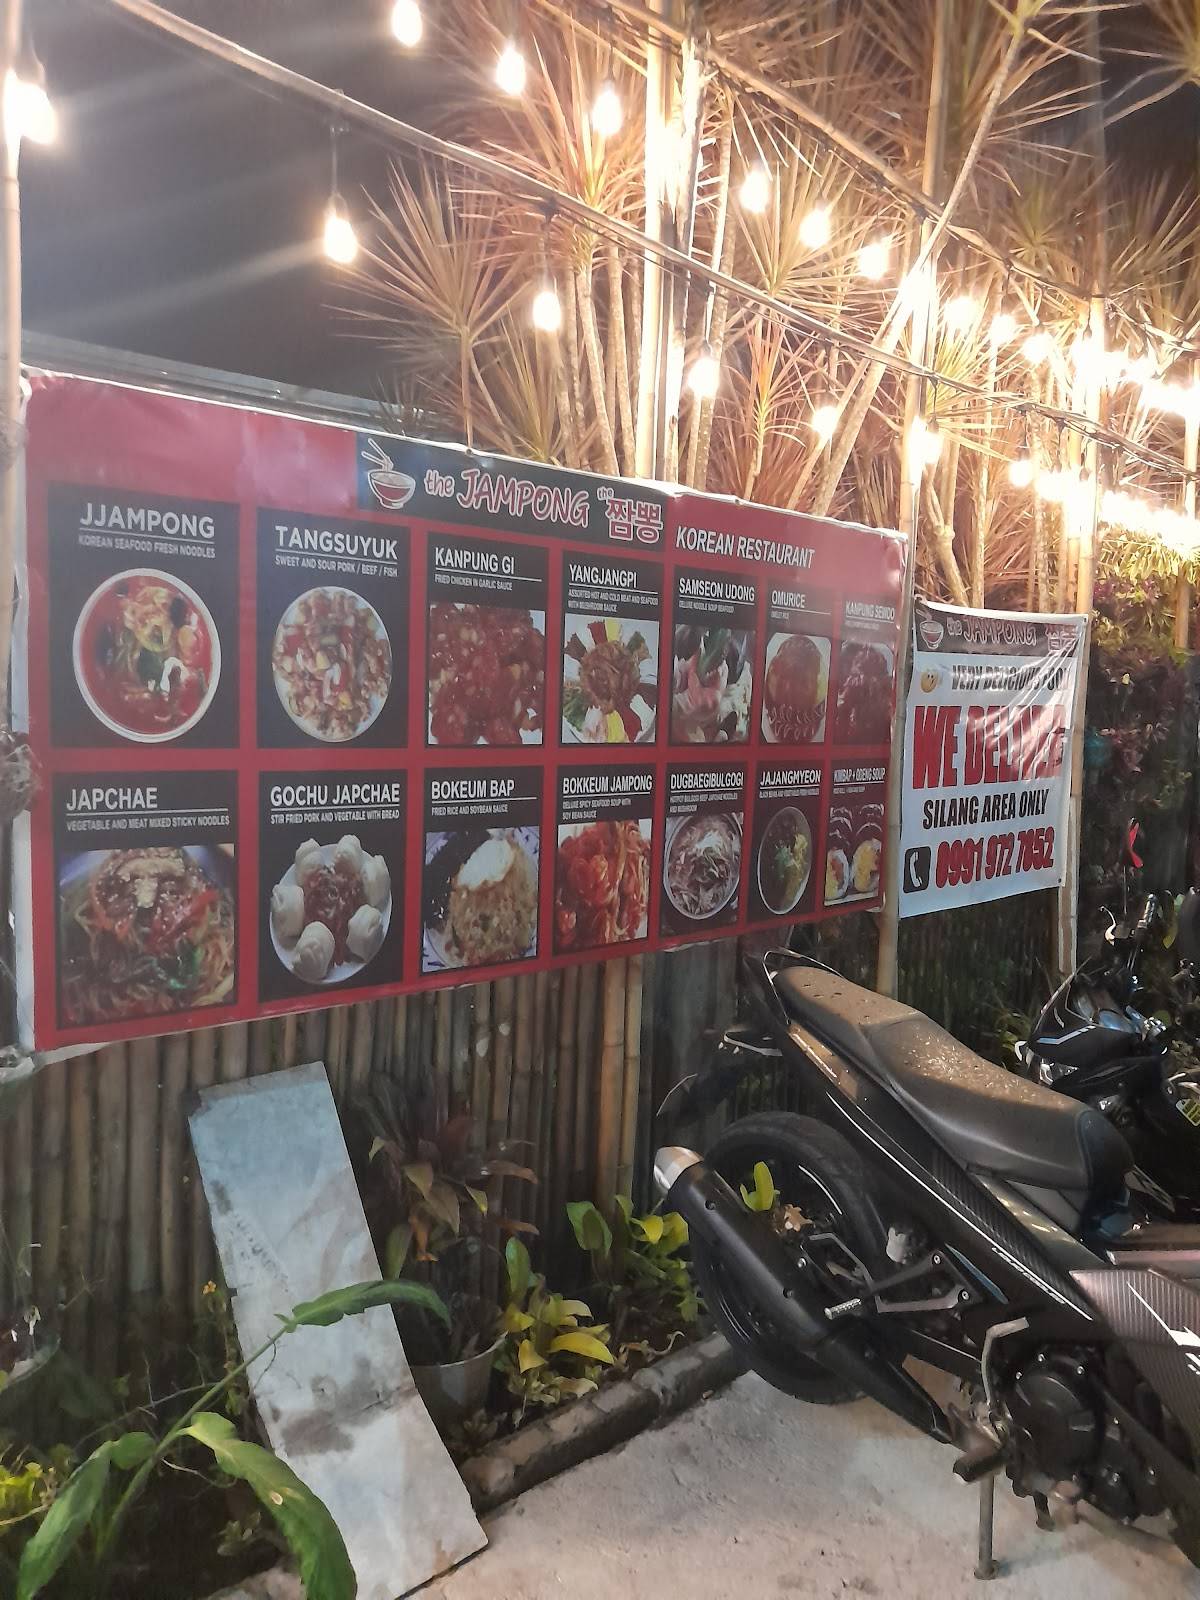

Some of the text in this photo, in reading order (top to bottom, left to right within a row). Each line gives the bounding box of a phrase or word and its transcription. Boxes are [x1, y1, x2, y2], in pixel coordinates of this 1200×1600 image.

[424, 468, 590, 528] the JAMPONG
[597, 486, 614, 500] the
[80, 502, 215, 539] JJAMPONG
[605, 498, 664, 543] 짬뽕
[80, 534, 216, 559] KOREAN SEAFOOD FRESH NOODLES
[275, 526, 398, 560] TANGSUYUK
[676, 526, 815, 569] KOREAN RESTAURANT
[275, 555, 300, 568] SWEET
[301, 556, 316, 569] AND
[318, 558, 336, 571] SOUR
[337, 562, 356, 573] PORK
[362, 565, 377, 576] BEEF
[384, 566, 398, 578] FISH
[436, 547, 514, 575] KANPUNG GI
[435, 574, 450, 584] FRIED
[479, 579, 496, 588] GARLIC
[497, 581, 512, 590] SAUCE
[570, 564, 636, 588] YANGJANGPI
[679, 578, 754, 602] SAMSEON UDONG
[771, 590, 805, 608] OMURICE
[964, 616, 1037, 647] JAMPONG
[912, 705, 962, 790] WE
[563, 774, 653, 794] BOKKEUM JAMPONG
[671, 772, 744, 790] DUGBAEGIBULGOGI
[760, 769, 822, 786] JAJANGMYEON
[66, 788, 158, 810] JAPCHAE
[270, 784, 400, 806] GOCHU JAPCHAE
[432, 780, 515, 800] BOKEUM BAP
[271, 809, 400, 824] STIR FRIED PORK AND VEGETABLE WITH BREAD
[432, 804, 508, 816] FRIED RICE AND SOYBEAN SAUCE
[923, 789, 1050, 830] SILANG AREA ONLY
[67, 815, 230, 832] VEGETABLE AND MEAT MIXED STICKY NOODLES
[936, 836, 984, 889] 0991
[984, 832, 1014, 880] 972
